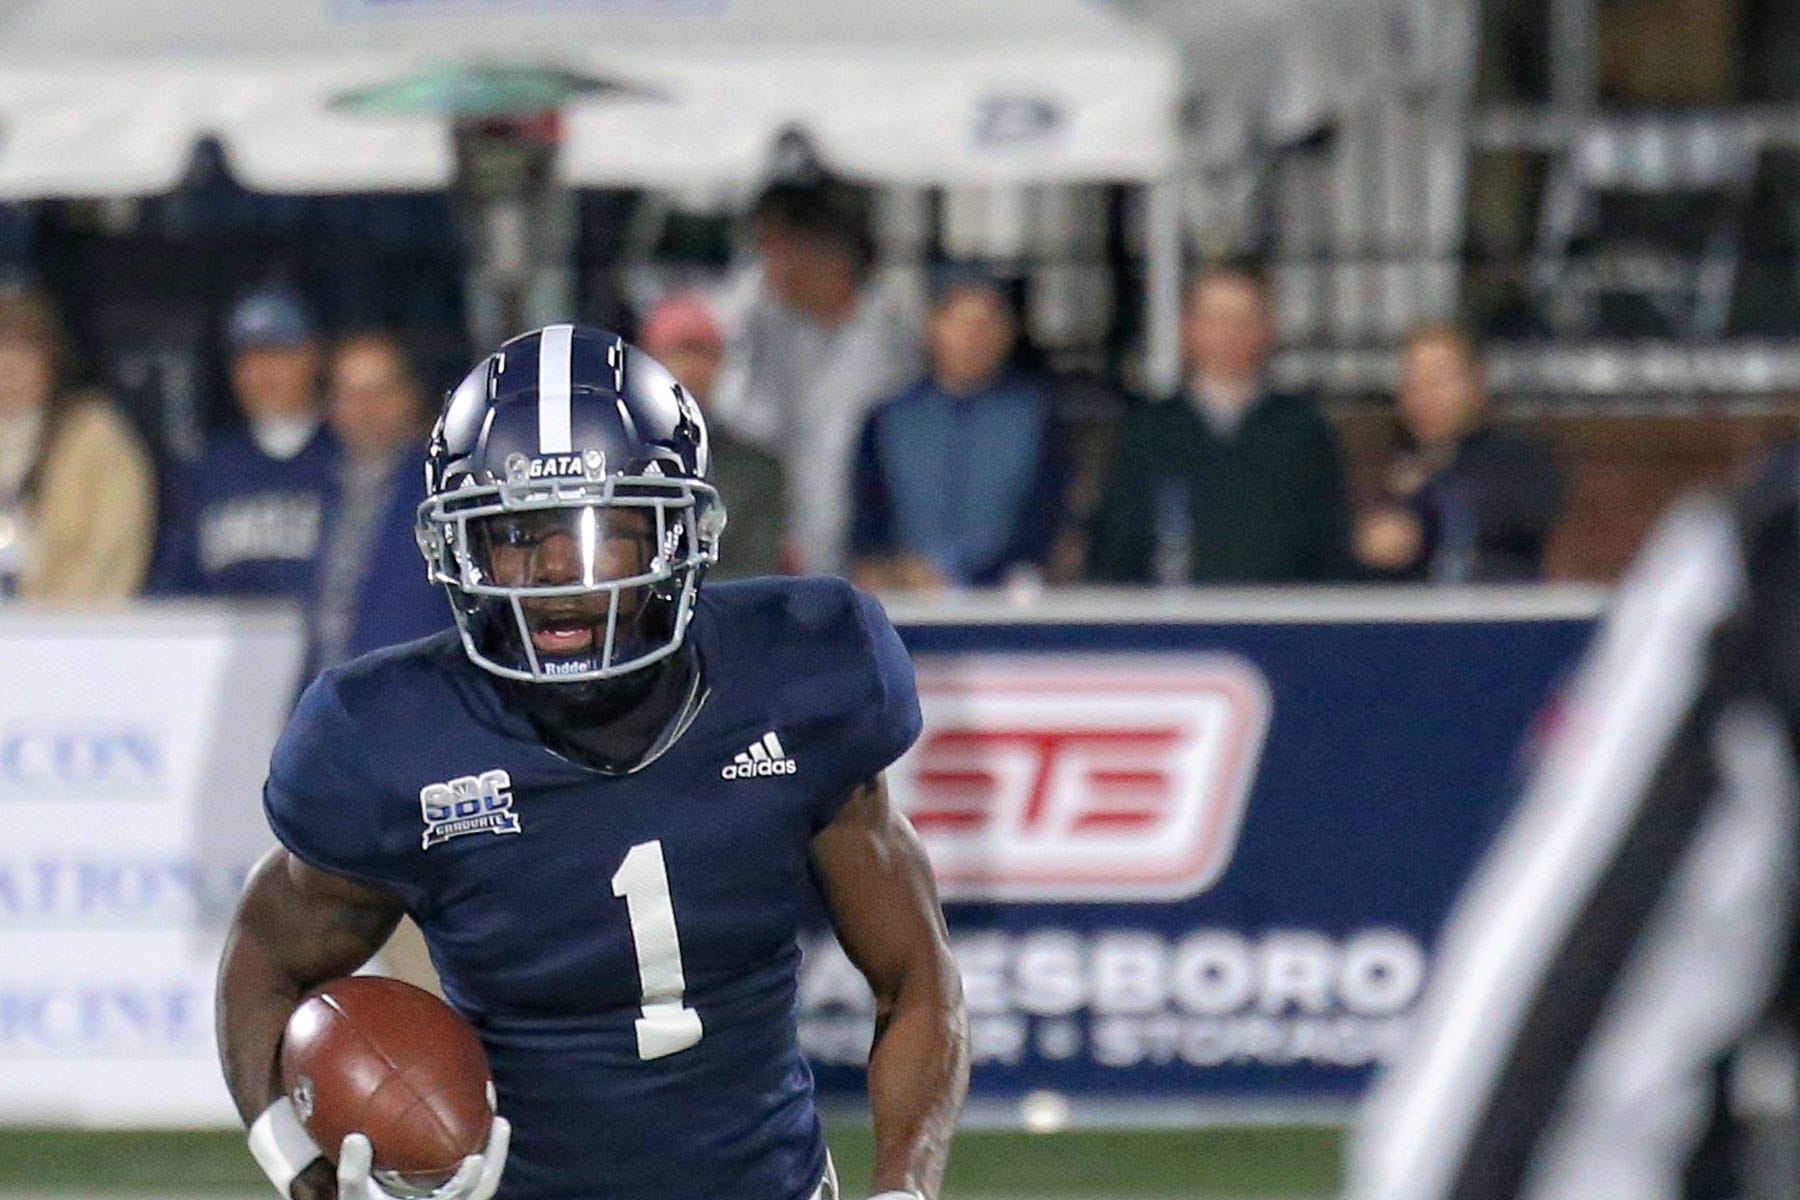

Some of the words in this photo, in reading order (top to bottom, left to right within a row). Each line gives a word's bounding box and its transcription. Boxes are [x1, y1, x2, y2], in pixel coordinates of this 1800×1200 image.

[529, 457, 582, 477] GATA
[721, 757, 797, 779] adidas
[421, 769, 513, 823] SBC
[611, 840, 703, 1061] 1
